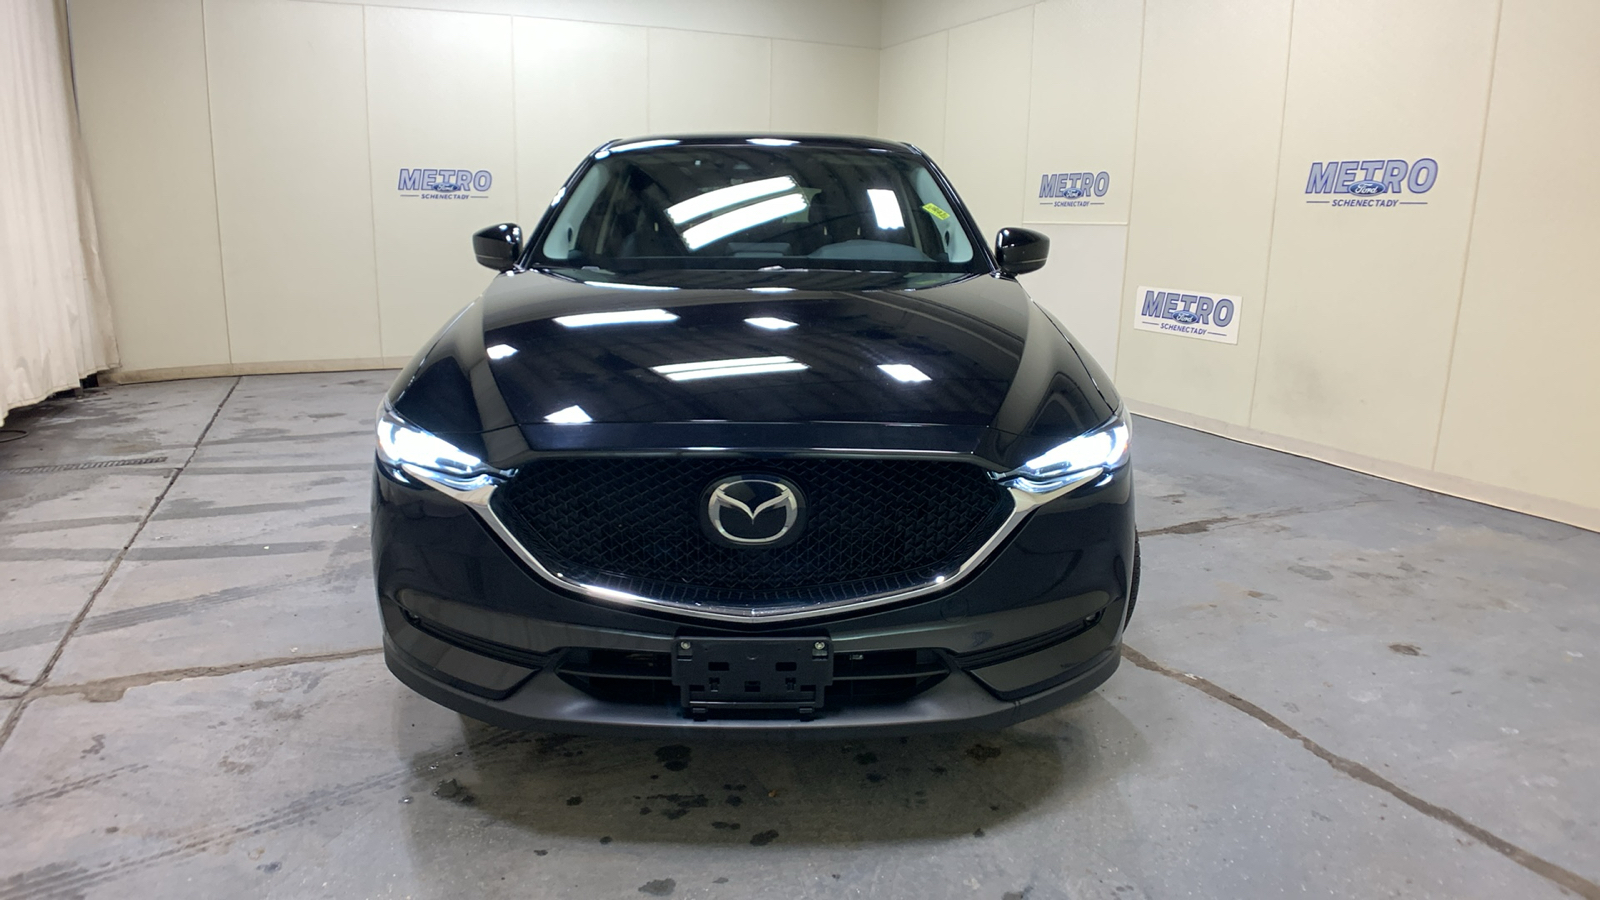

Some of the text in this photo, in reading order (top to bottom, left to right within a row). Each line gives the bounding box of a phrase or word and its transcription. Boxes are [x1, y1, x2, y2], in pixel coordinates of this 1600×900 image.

[398, 168, 492, 192] METRO
[1039, 171, 1110, 198] METRO
[1305, 158, 1438, 194] METRO
[1354, 183, 1378, 194] Ford
[1331, 199, 1399, 207] SCHENECTADY
[1141, 290, 1234, 327] METRO
[1160, 323, 1207, 335] SCHENECTADY
